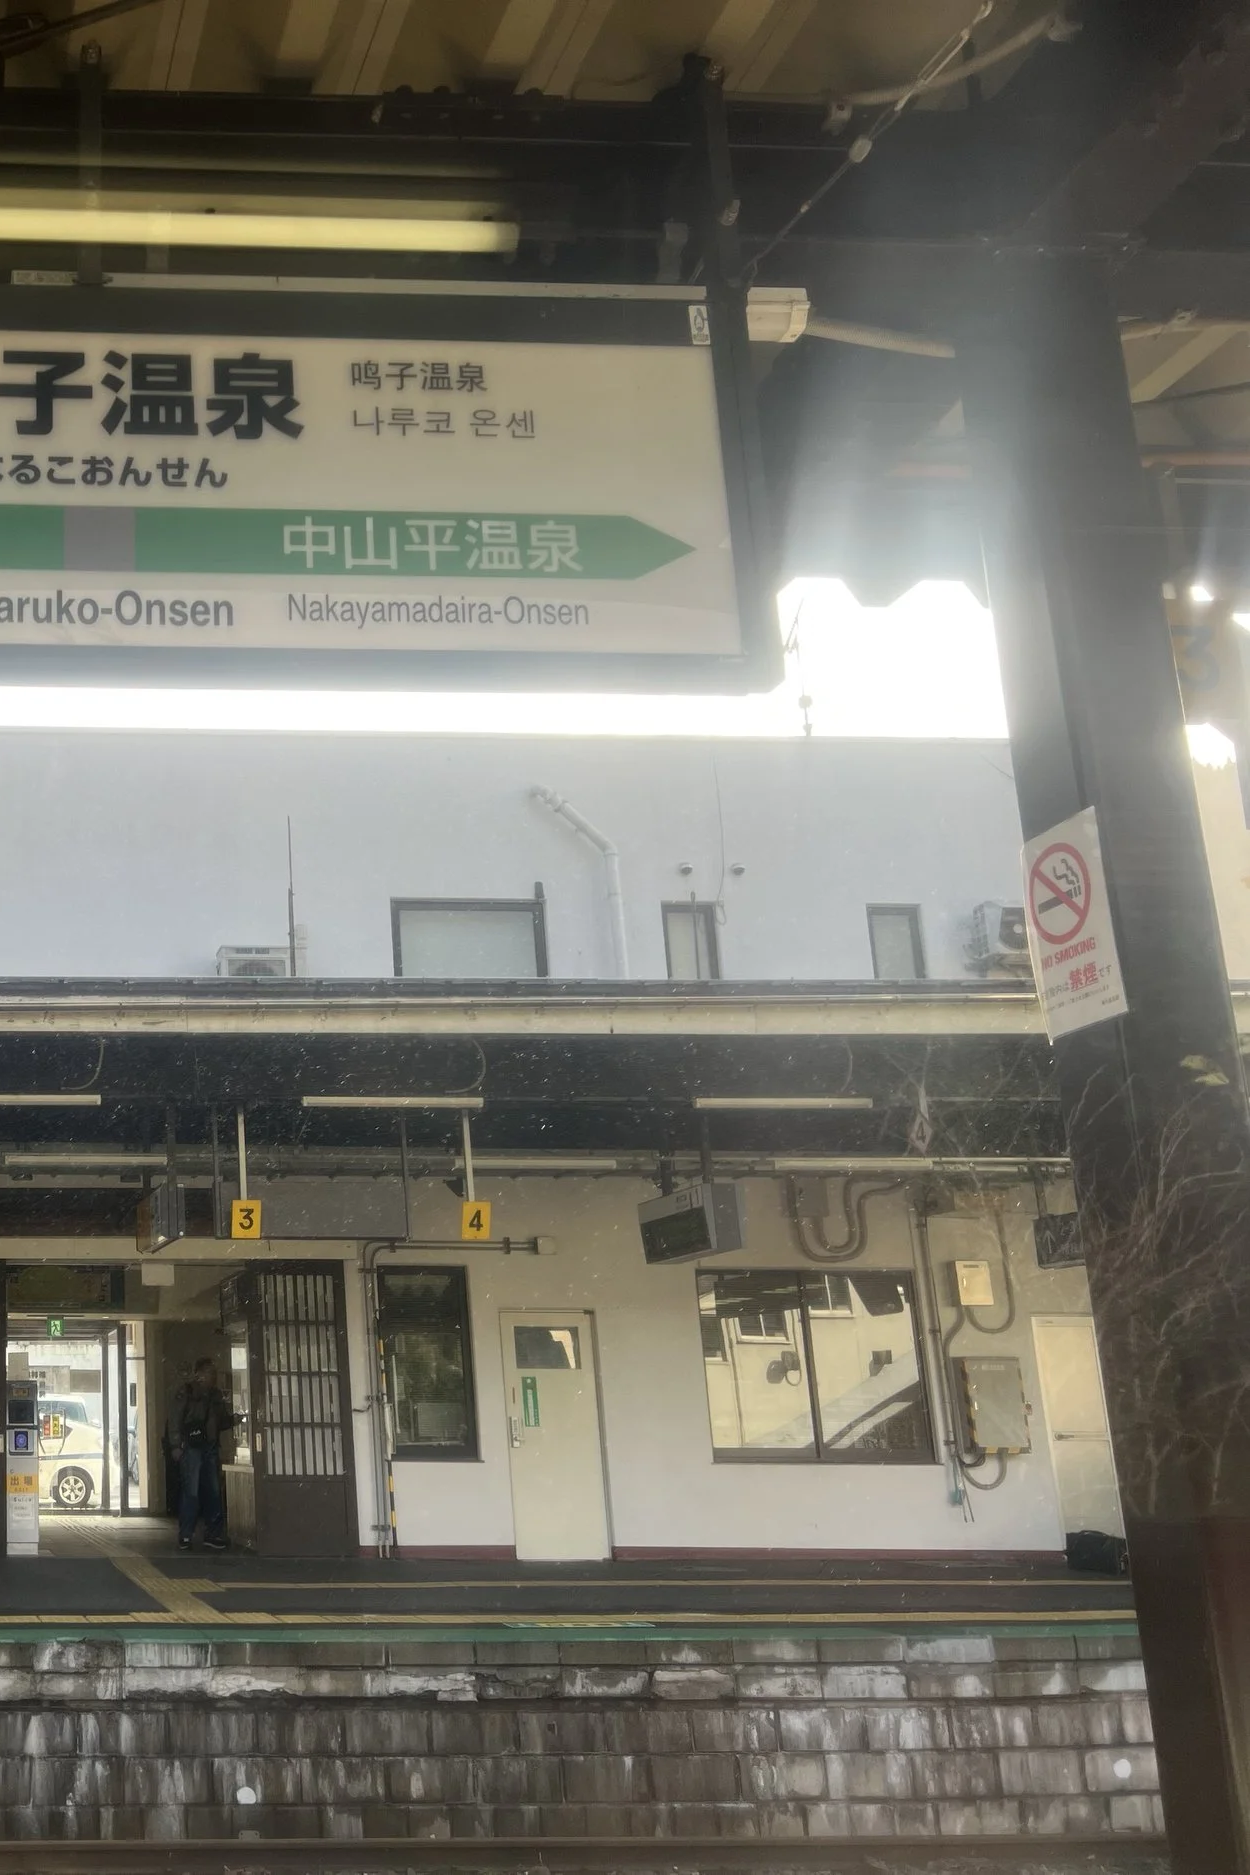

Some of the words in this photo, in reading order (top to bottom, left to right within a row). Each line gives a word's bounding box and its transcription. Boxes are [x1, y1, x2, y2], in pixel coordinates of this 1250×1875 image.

[351, 360, 489, 393] 鸣子温泉
[352, 406, 456, 437] 나루코
[469, 409, 537, 440] 온센
[282, 515, 584, 574] 中山平温泉
[287, 594, 590, 630] Nakayamadaira-Onsen
[1171, 625, 1220, 692] 3
[1054, 937, 1096, 964] SMOKING
[916, 1119, 926, 1142] 4
[238, 1208, 254, 1230] 3
[468, 1210, 483, 1231] 4
